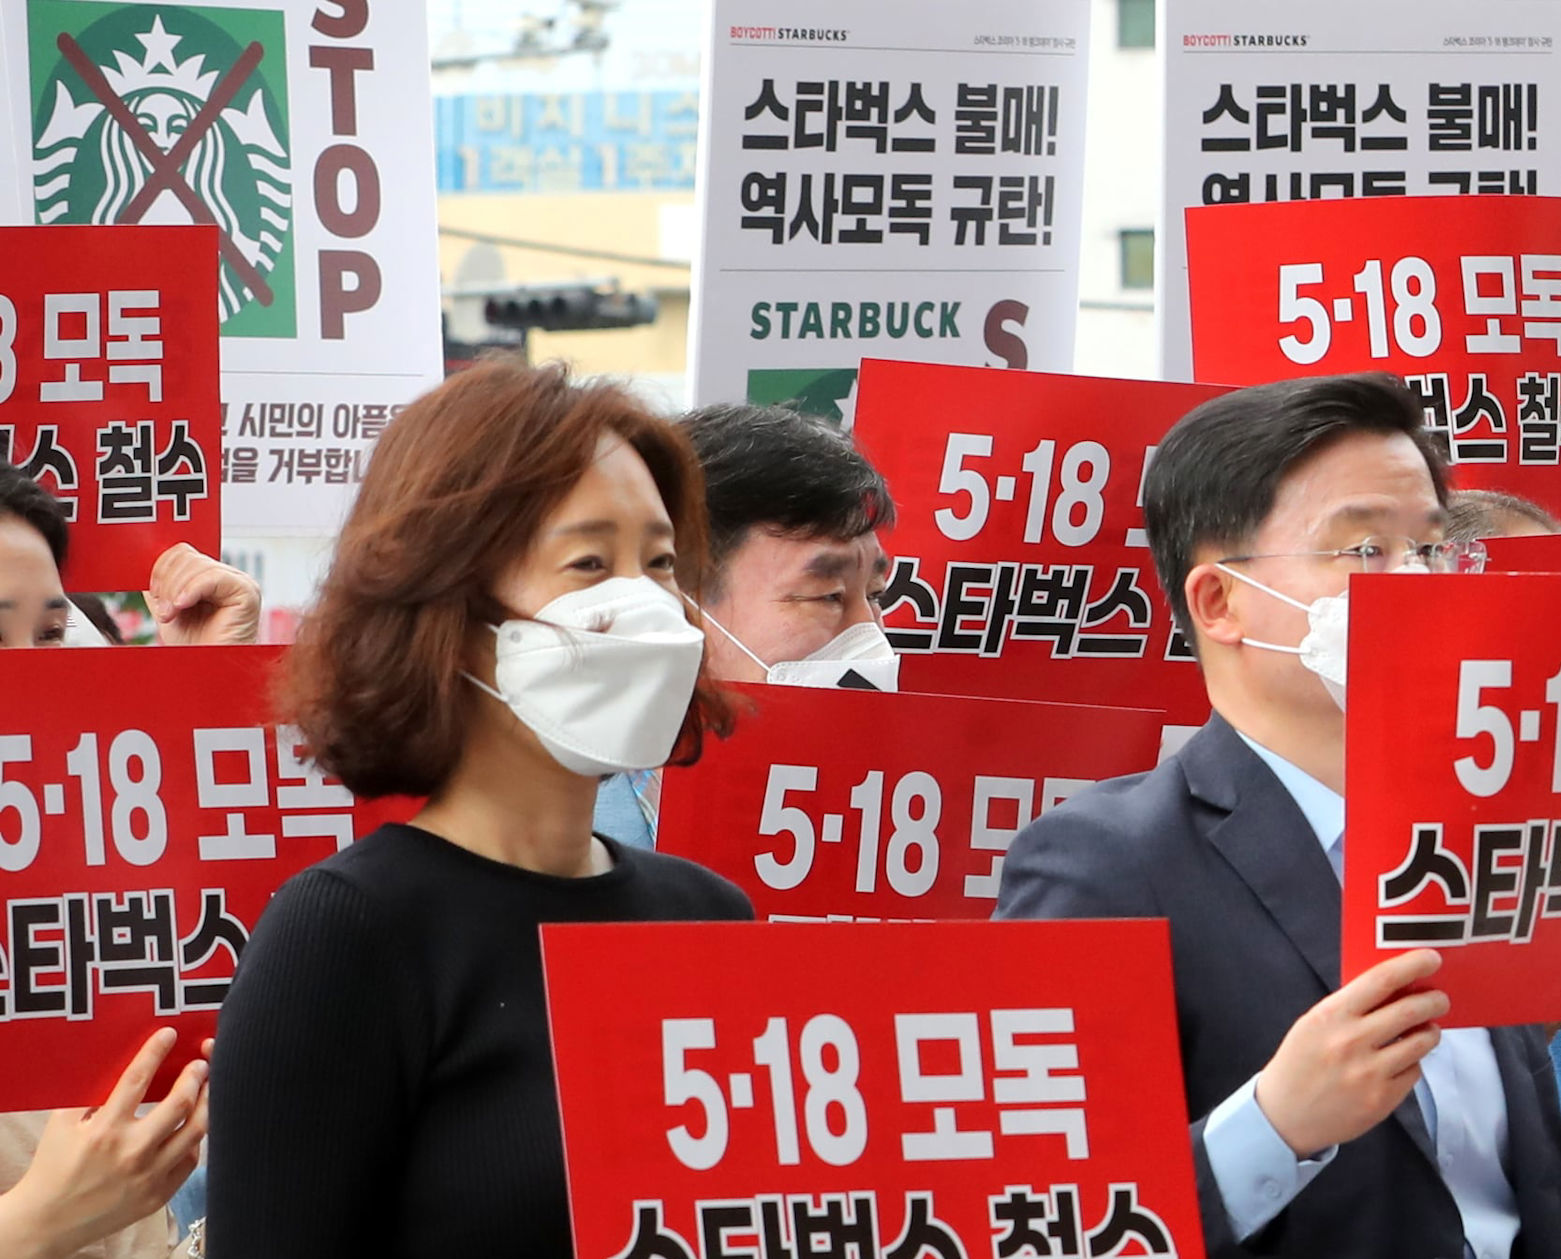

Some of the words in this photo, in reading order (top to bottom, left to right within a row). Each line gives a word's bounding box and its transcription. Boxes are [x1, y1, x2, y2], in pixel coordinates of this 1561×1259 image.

[778, 27, 848, 41] STARBUCKS
[1233, 35, 1308, 47] STARBUCKS
[742, 79, 937, 154] 스타벅스
[955, 84, 1060, 157] 불매!
[1201, 83, 1408, 153] 스타벅스
[1427, 83, 1537, 151] 불매!
[739, 171, 933, 246] 역사모독
[949, 176, 1055, 248] 규탄!
[40, 290, 164, 402] 모독
[749, 301, 961, 341] STARBUCK
[238, 403, 324, 439] 시민의
[332, 404, 408, 438] 아픔
[97, 420, 208, 524] 철수
[882, 556, 1152, 661] 스타벅스
[193, 724, 355, 861] 모독
[893, 1007, 1091, 1161] 모독
